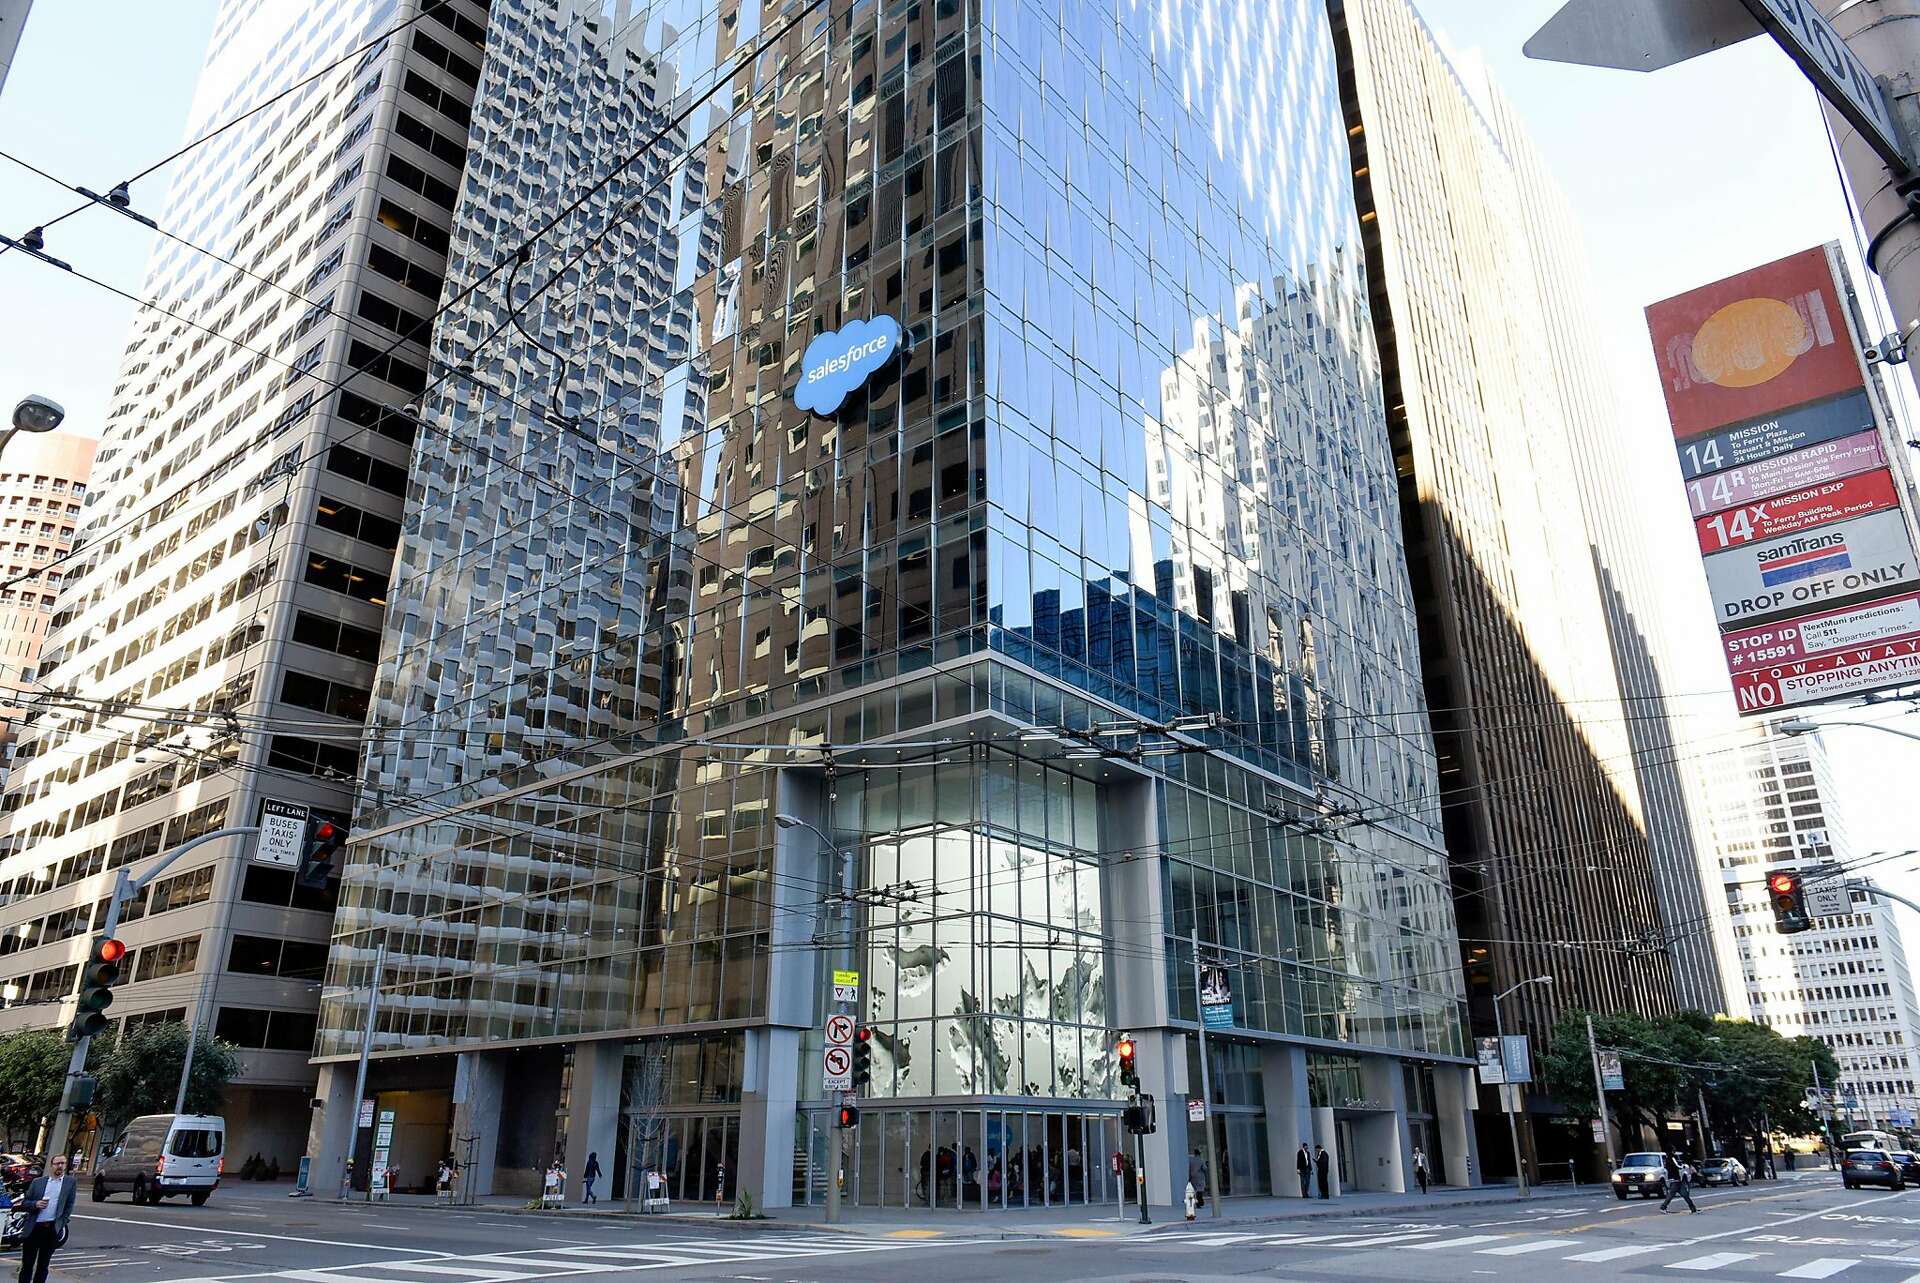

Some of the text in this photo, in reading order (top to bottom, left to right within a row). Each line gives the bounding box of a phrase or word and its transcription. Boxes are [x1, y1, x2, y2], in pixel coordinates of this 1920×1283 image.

[807, 335, 887, 384] salesforce
[1729, 420, 1779, 442] MISSION
[1744, 437, 1764, 445] Ferry
[1766, 429, 1788, 439] Plaza
[1733, 444, 1763, 457] Steuart
[1773, 431, 1806, 445] Mission
[1746, 449, 1771, 461] Hours
[1773, 442, 1794, 453] Daily
[1686, 440, 1724, 474] 14
[1747, 443, 1837, 475] MISSION RAPID
[1750, 444, 1876, 483] To Main/Mission via Ferry Plaza
[1751, 477, 1784, 490] Mon-Fri
[1753, 484, 1787, 498] Sat/Sun
[1771, 482, 1845, 509] MISSION EXP
[1764, 500, 1874, 534] Weekday AM Peak Period
[1774, 514, 1796, 524] Ferry
[1798, 504, 1834, 518] Building
[1757, 532, 1844, 563] samTrans
[1724, 563, 1906, 617] DROP OFF ONLY
[1803, 606, 1904, 631] NextMuni predictions:
[1728, 628, 1797, 652] STOP ID
[1805, 631, 1822, 640] Call
[1732, 643, 1796, 666] # 15591
[1740, 682, 1776, 710] NO
[1786, 667, 1863, 690] STOPPING
[1820, 683, 1843, 692] Towed
[1844, 679, 1862, 688] Cars
[1863, 675, 1887, 684] Phone
[267, 803, 306, 818] LEFT LANE
[269, 817, 298, 830] BUSES
[271, 828, 294, 839] TAXIS
[269, 838, 292, 848] ONLY
[1814, 885, 1838, 893] TAXIS
[1817, 894, 1838, 903] ONLY
